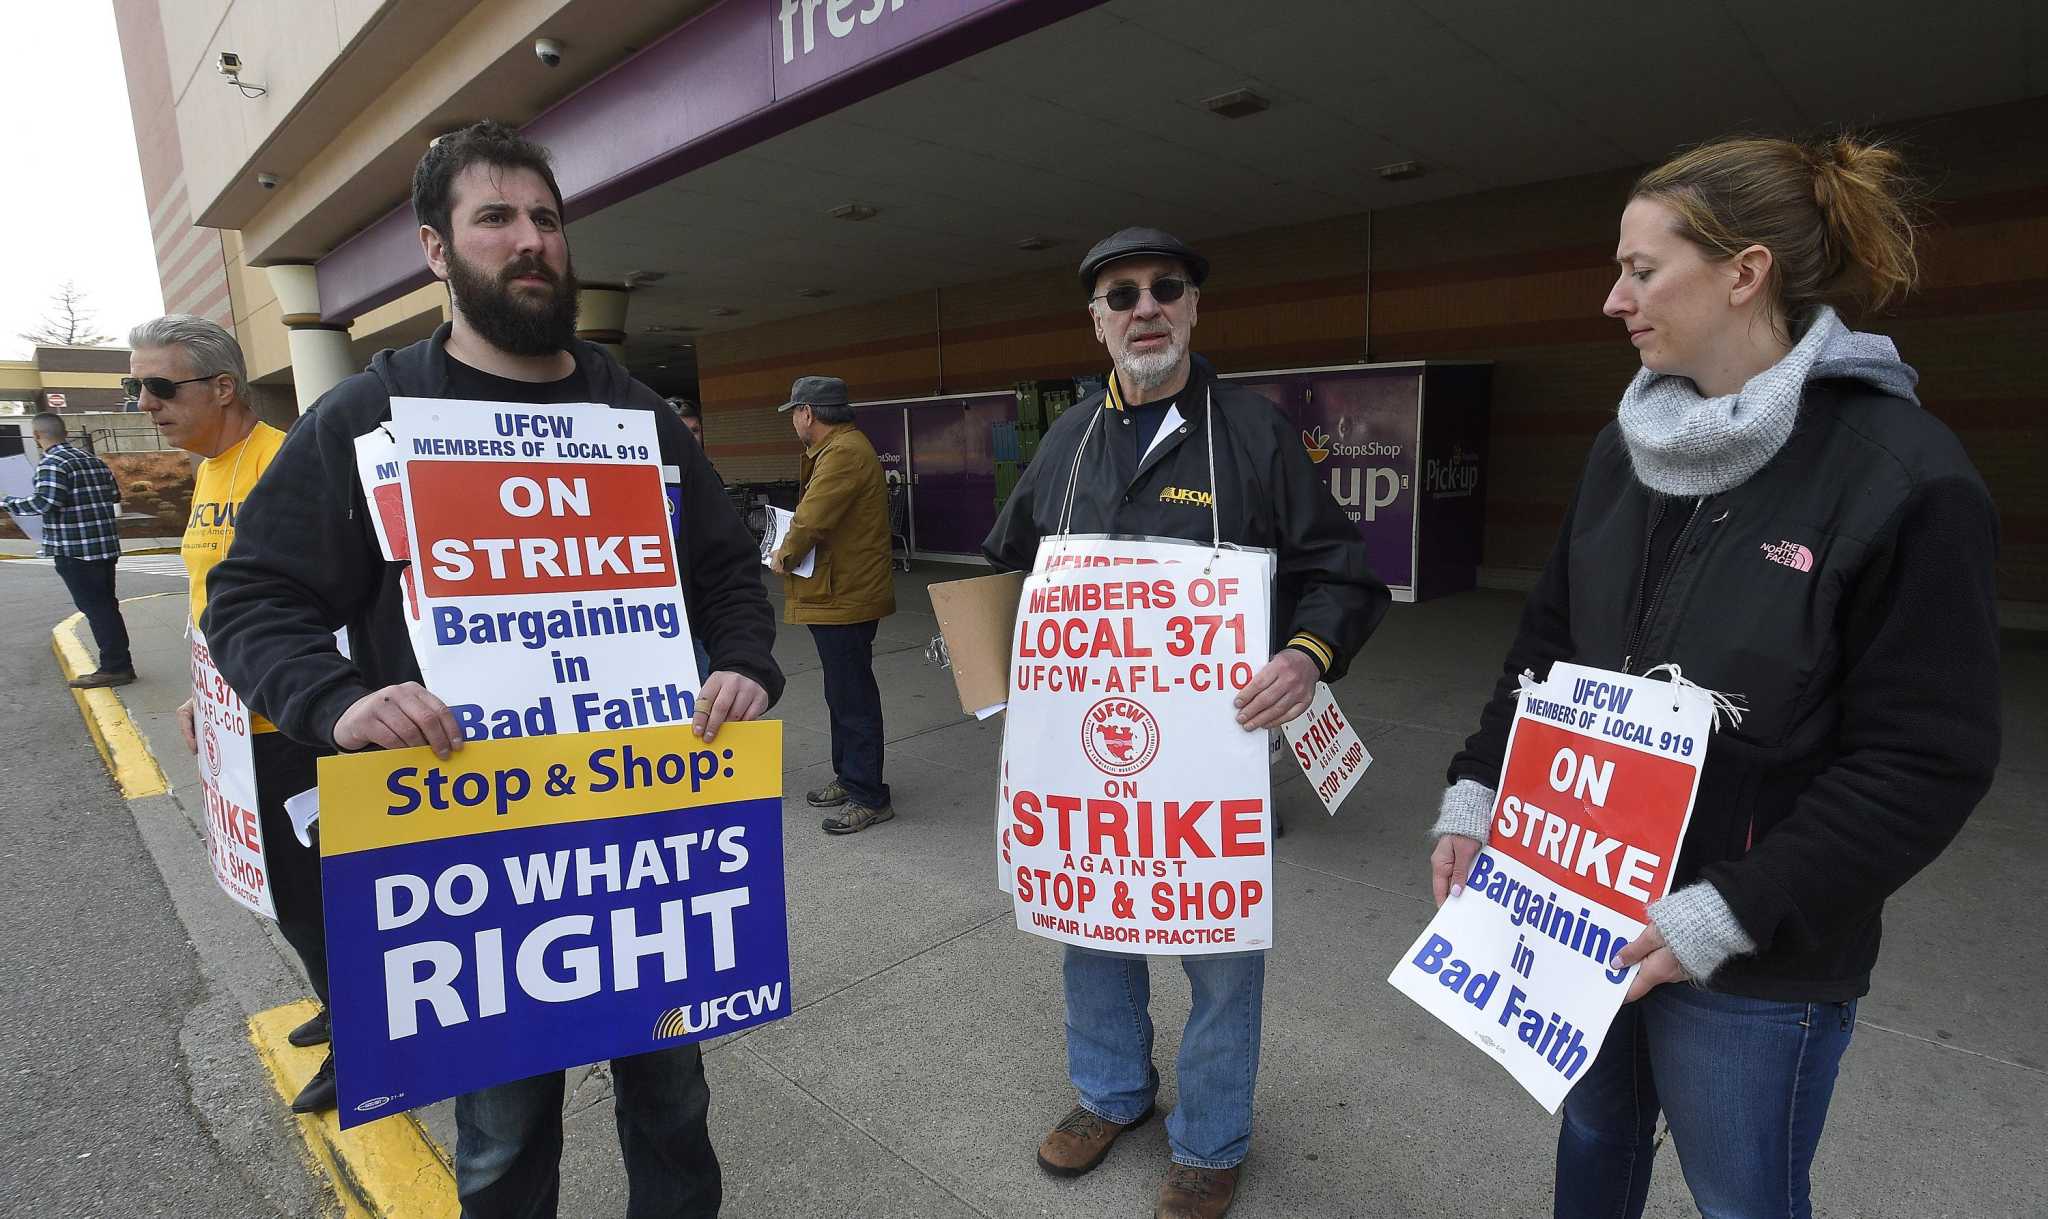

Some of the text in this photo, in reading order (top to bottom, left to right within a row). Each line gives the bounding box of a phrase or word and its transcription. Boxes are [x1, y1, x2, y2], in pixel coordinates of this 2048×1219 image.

[494, 413, 574, 439] UFCW
[413, 438, 649, 460] MEMBERS OF LOCAL 919
[1332, 442, 1400, 459] Stop&Shop
[499, 476, 591, 518] ON
[1170, 487, 1212, 504] UFCW
[1331, 467, 1400, 521] up
[1345, 511, 1361, 523] up
[431, 535, 666, 581] STRIKE
[1760, 542, 1796, 559] NORTH
[1765, 552, 1791, 567] FACE
[1780, 540, 1800, 552] THE
[1029, 578, 1239, 613] MEMBERS OF
[432, 597, 680, 649] Bargaining
[1019, 613, 1246, 658] LOCAL 371
[551, 650, 590, 683] in
[1017, 661, 1253, 693] UFCW-AFL-CIO
[453, 684, 695, 741] Bad Faith
[1092, 703, 1146, 723] UFCW
[1573, 677, 1633, 715] UFCW
[1295, 703, 1344, 770] STRIKE
[1526, 696, 1694, 757] MEMBERS OF LOCAL 919
[1318, 741, 1363, 804] STOP & SHOP
[1319, 740, 1342, 770] AGAINST
[1549, 747, 1616, 808] ON
[386, 745, 735, 816] Stop & Shop:
[1104, 780, 1137, 798] ON
[202, 779, 260, 854] TRIKE
[1012, 790, 1265, 858] STRIKE
[1063, 853, 1187, 877] AGAINST
[1498, 795, 1661, 903] STRIKE
[229, 852, 264, 892] SHOP
[374, 825, 749, 931] DO WHAT'S
[1017, 866, 1263, 921] STOP & SHOP
[1032, 912, 1236, 945] UNFAIR LABOR PRACTICE
[1466, 852, 1633, 985] Bargaining
[383, 887, 751, 1040] RIGHT
[1510, 933, 1535, 979] in
[679, 982, 783, 1033] UFCW
[1412, 933, 1589, 1081] Bad Faith
